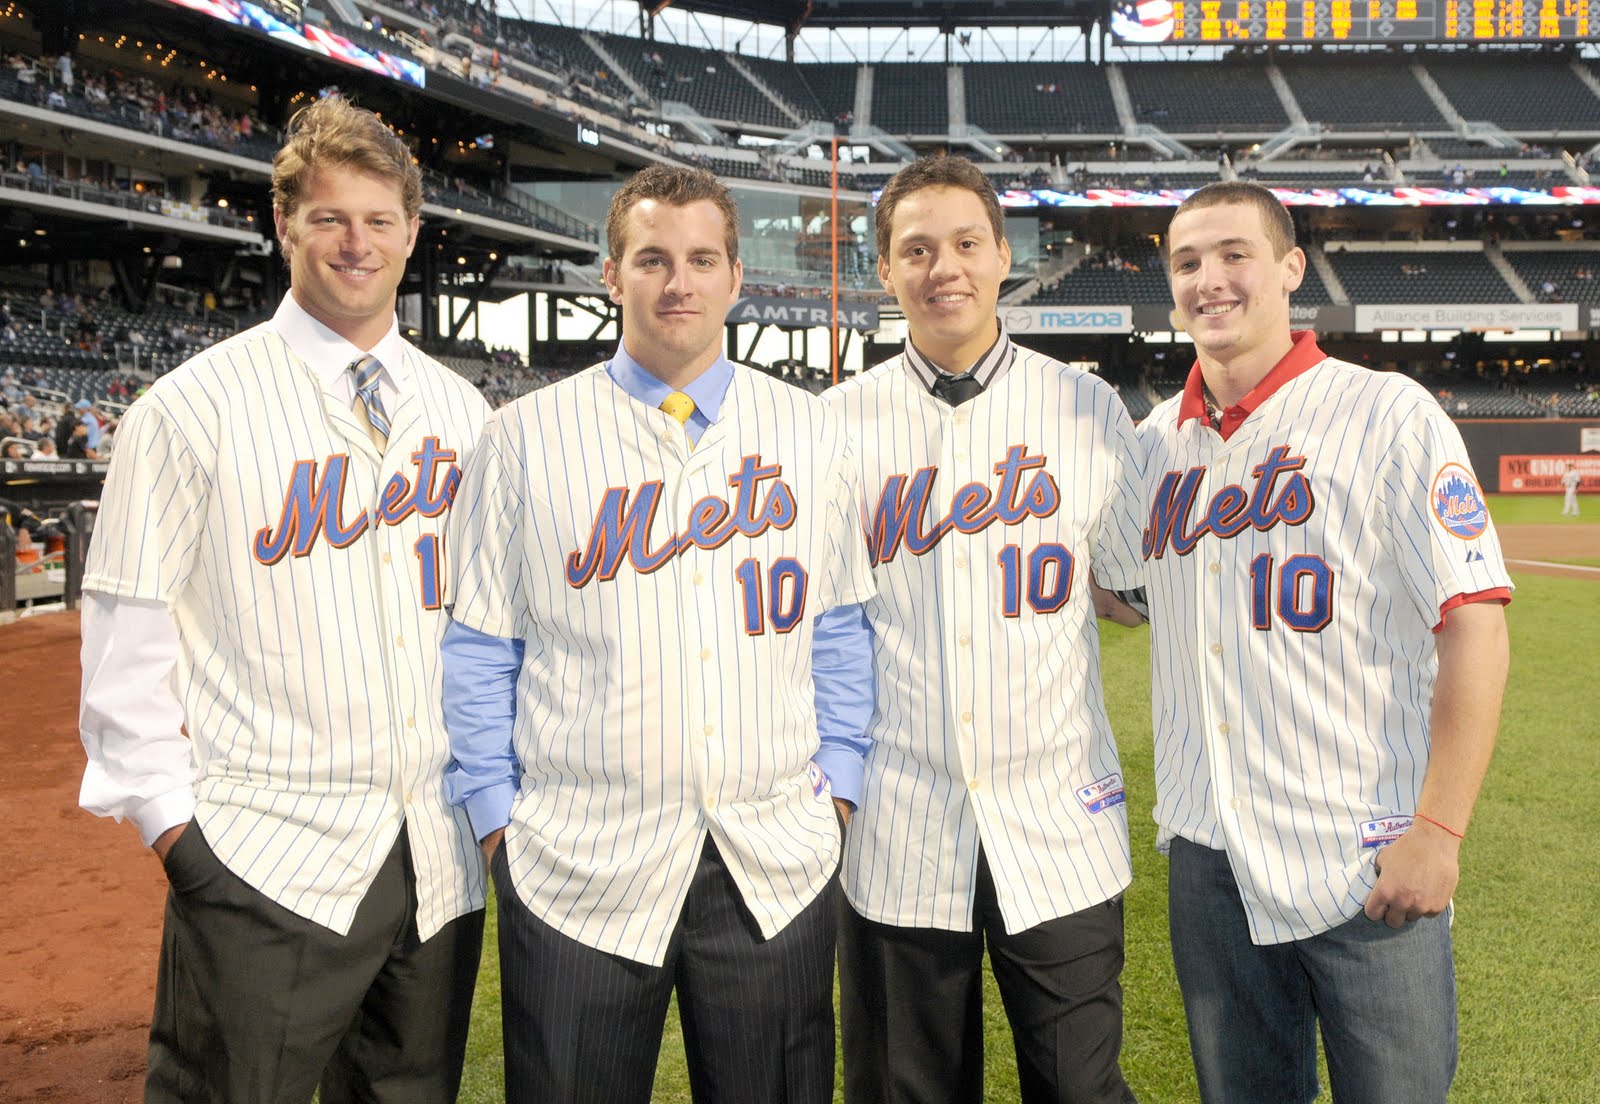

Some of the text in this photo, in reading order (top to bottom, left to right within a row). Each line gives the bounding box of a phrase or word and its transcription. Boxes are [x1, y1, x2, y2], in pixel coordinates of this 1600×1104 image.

[740, 302, 869, 326] AMTRAK
[1040, 311, 1122, 328] mazda
[1373, 308, 1562, 325] Alliance Building Services
[566, 454, 797, 589] Mets
[866, 444, 1061, 568] Mets
[1142, 444, 1315, 562] Mets
[1443, 494, 1478, 517] Mets
[413, 533, 447, 610] 1
[735, 557, 808, 636] 10
[997, 543, 1075, 618] 10
[1250, 553, 1334, 632] 10
